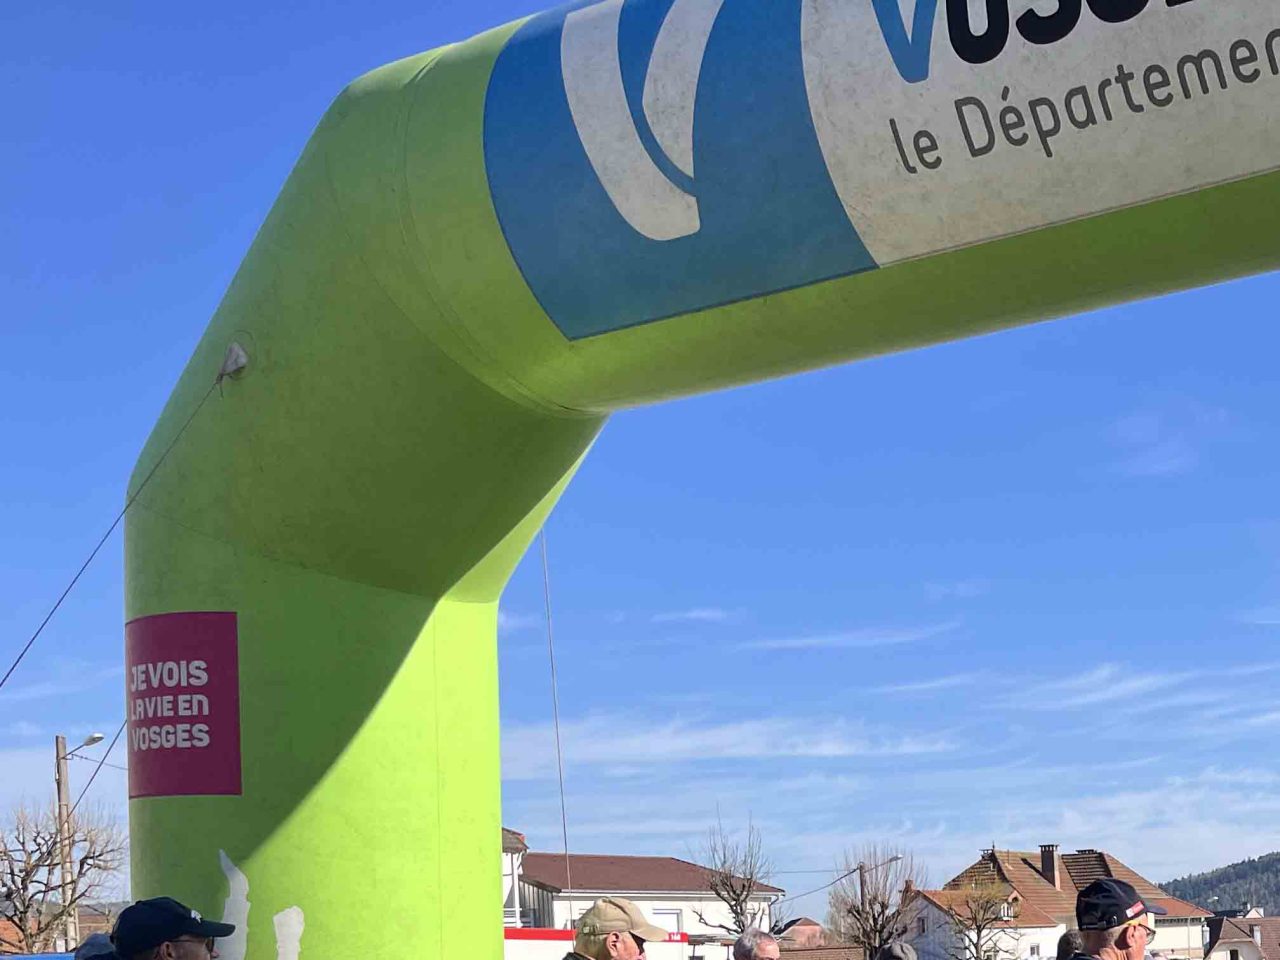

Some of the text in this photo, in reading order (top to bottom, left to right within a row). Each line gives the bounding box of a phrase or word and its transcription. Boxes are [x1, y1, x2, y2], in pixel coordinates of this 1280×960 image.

[888, 118, 942, 174] le
[132, 660, 208, 692] JE VOIS
[145, 695, 174, 718] VIE
[132, 723, 210, 752] VOSGES
